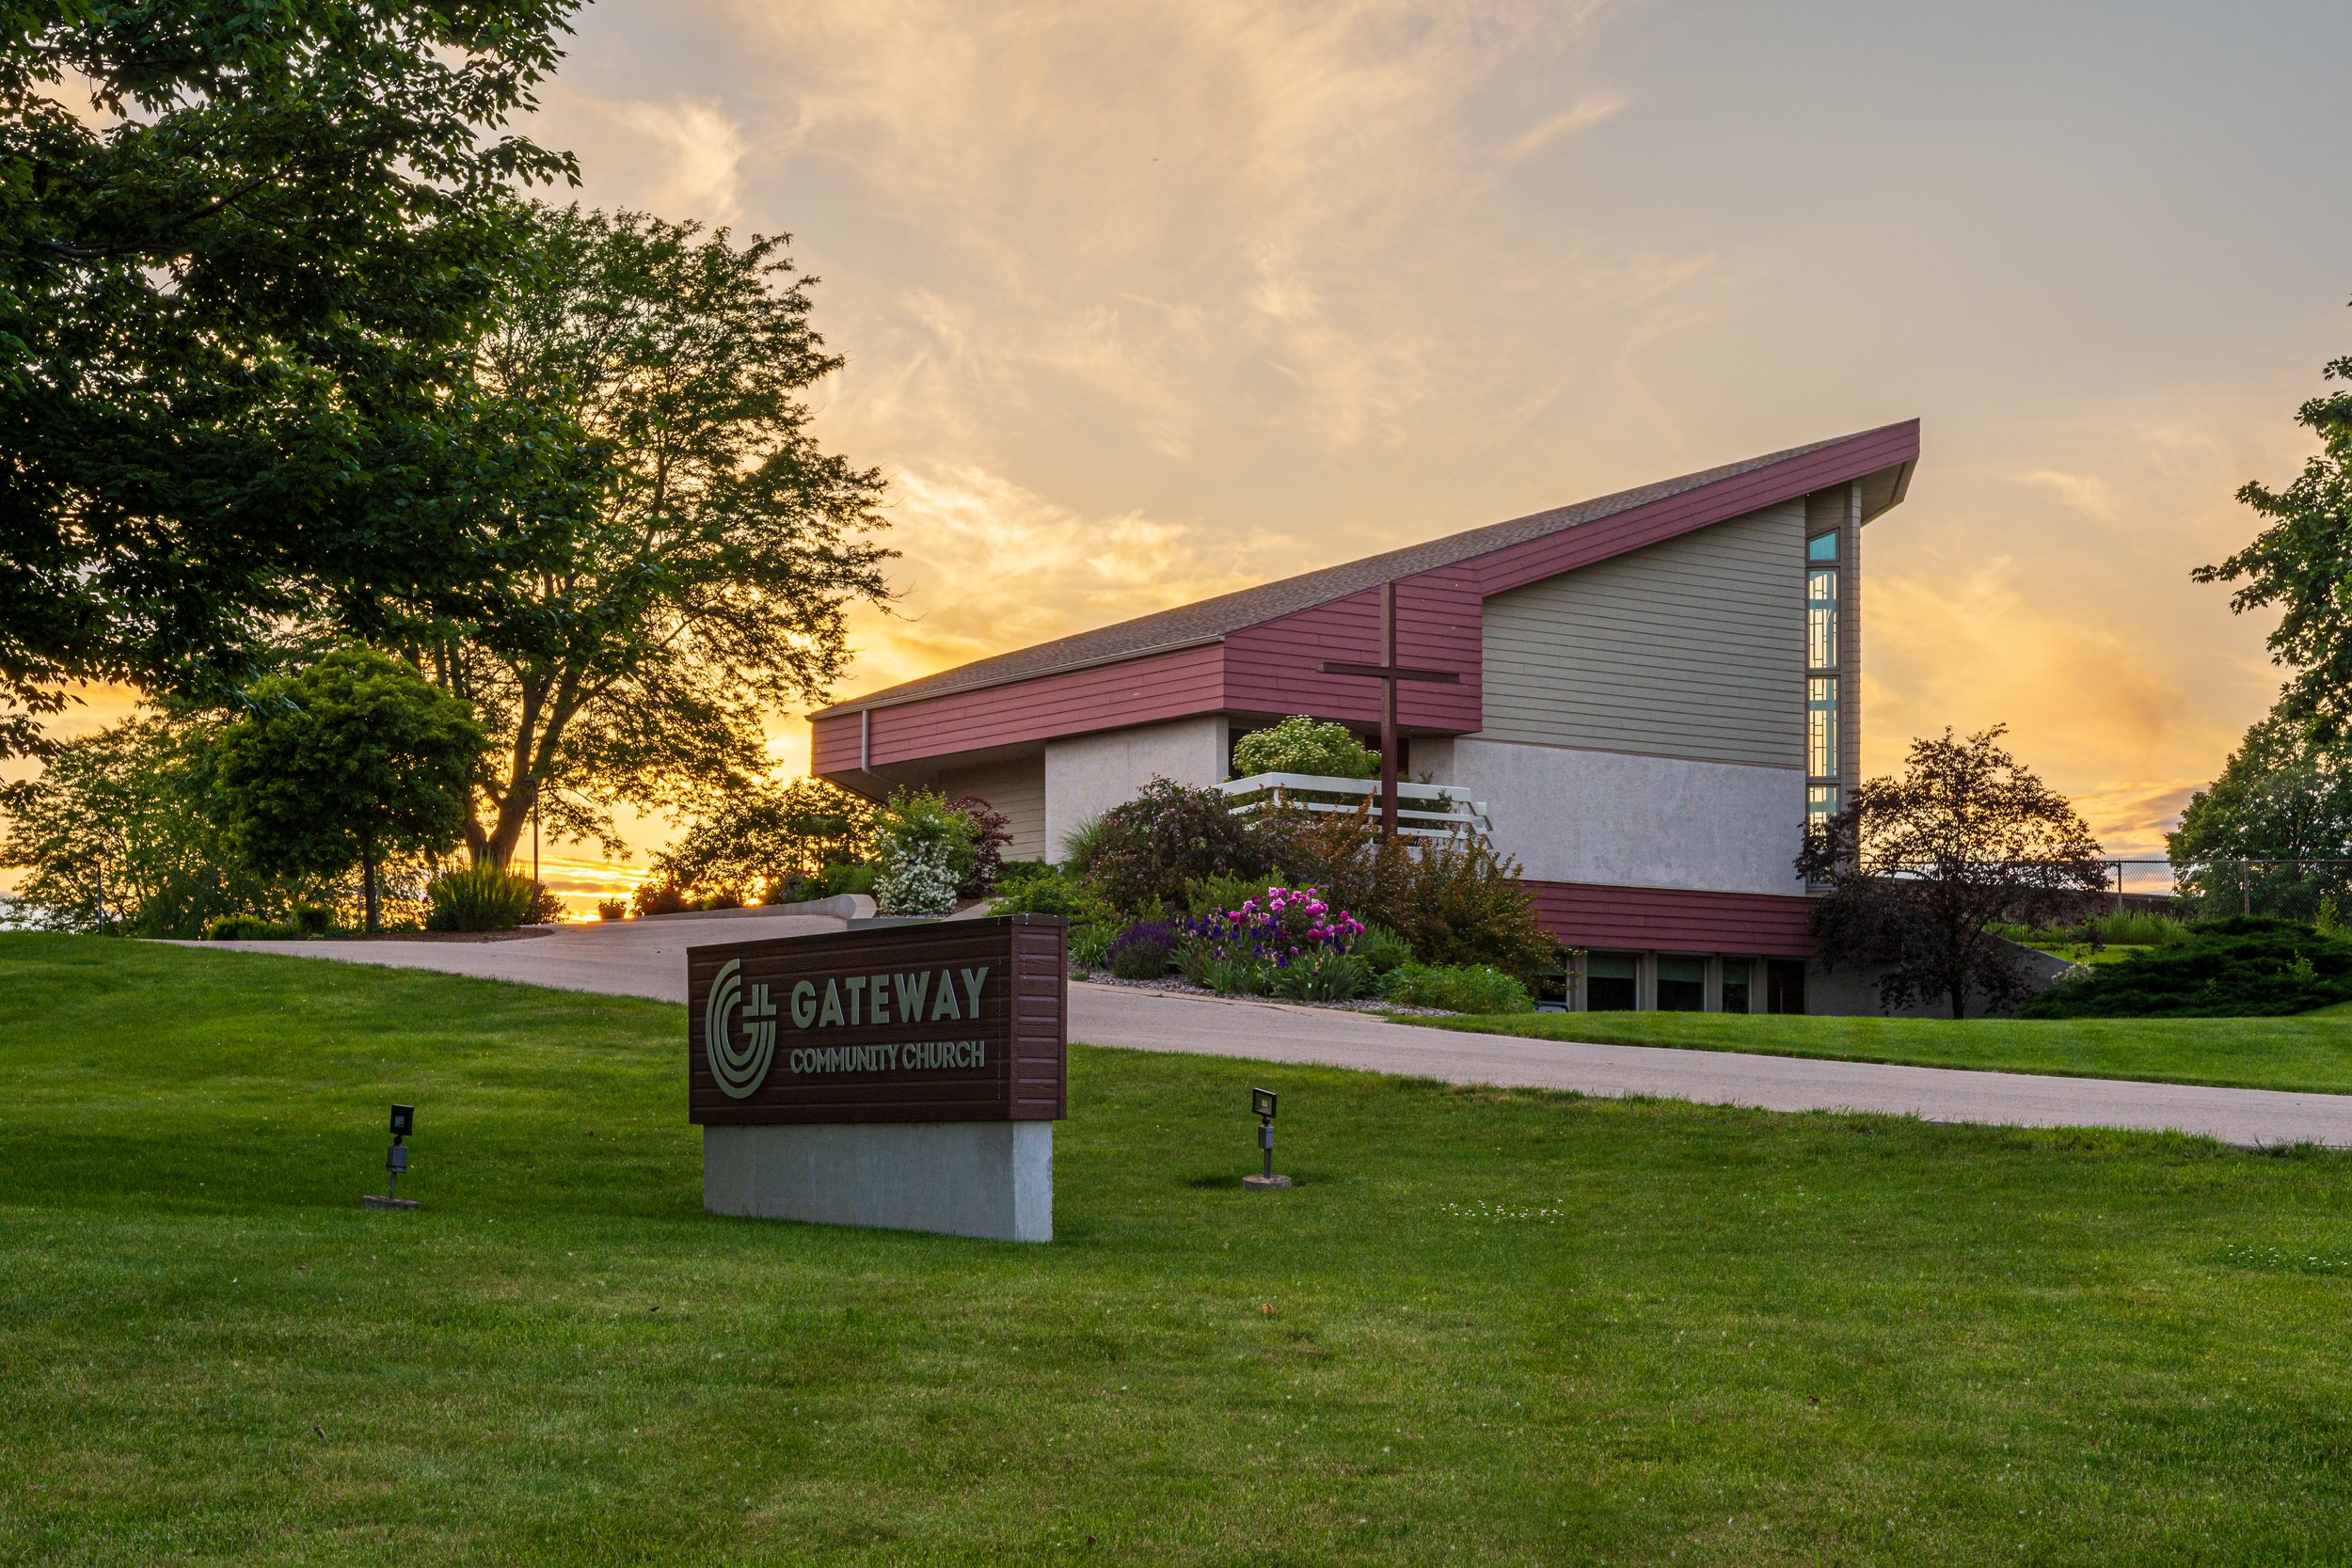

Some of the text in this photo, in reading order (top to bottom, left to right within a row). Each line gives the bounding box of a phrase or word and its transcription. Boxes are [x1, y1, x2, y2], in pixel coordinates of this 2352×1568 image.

[790, 966, 989, 1029] GATEWAY
[789, 1039, 986, 1074] COMMUNITY CHURCH
